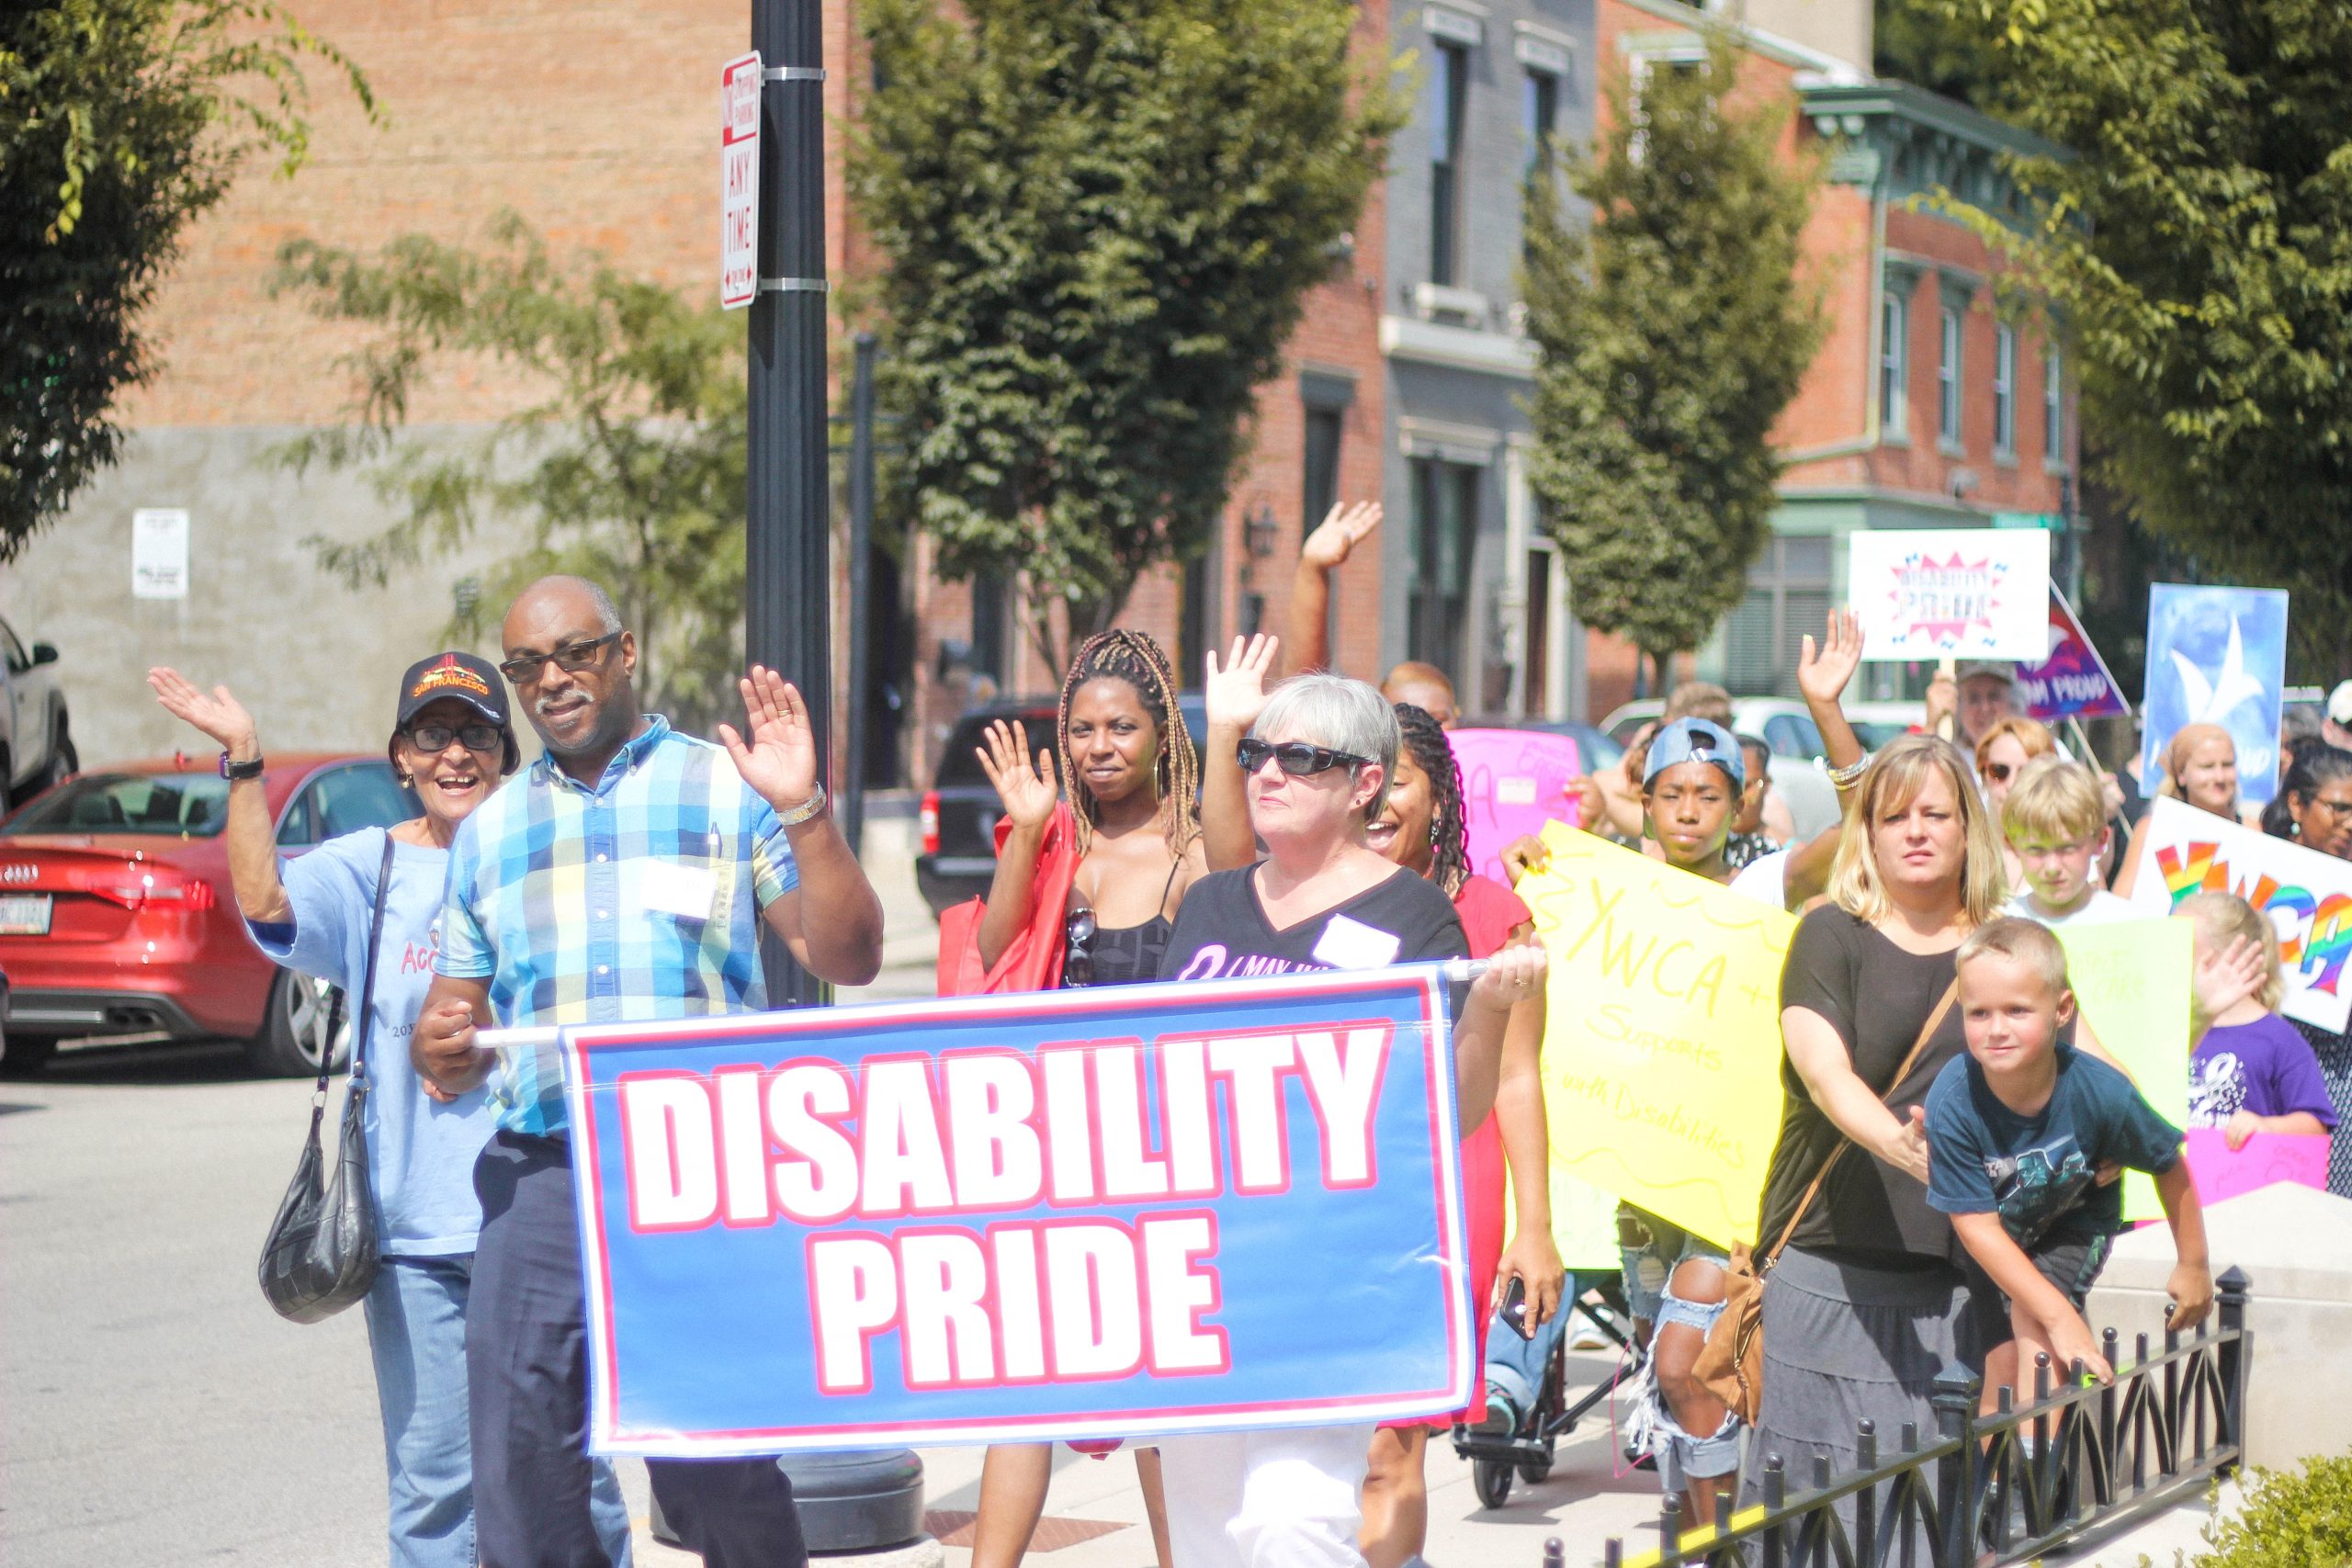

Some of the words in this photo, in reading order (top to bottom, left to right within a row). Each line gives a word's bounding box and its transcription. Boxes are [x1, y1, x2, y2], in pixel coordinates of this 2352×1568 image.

[729, 151, 751, 198] ANY
[728, 205, 751, 254] TIME
[413, 682, 431, 698] SAN
[433, 676, 490, 696] FRANCISCO
[2052, 672, 2108, 704] PROUD
[1564, 875, 1728, 1020] YWCA
[618, 1019, 1393, 1233] DISABILITY
[1561, 1070, 1608, 1106] with
[1614, 1080, 1747, 1171] Disabilities
[805, 1208, 1231, 1395] PRIDE
